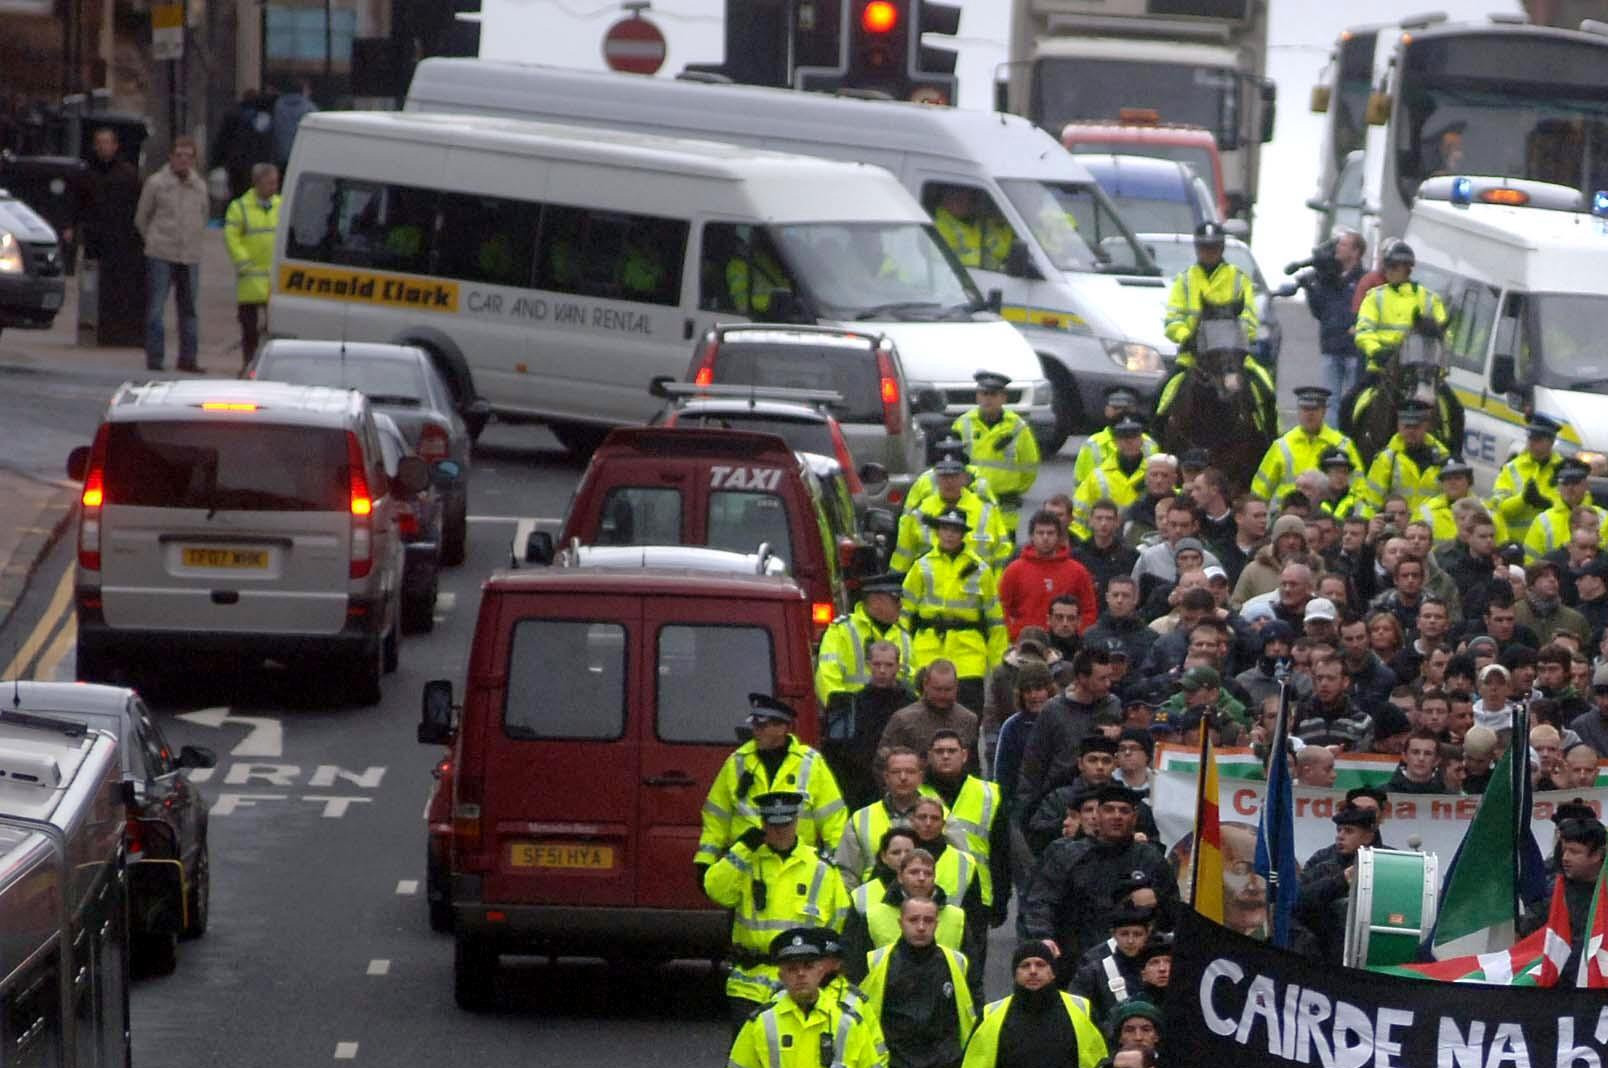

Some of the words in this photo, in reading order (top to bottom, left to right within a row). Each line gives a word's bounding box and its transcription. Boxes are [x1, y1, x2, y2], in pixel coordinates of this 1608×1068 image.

[286, 270, 374, 298] Arnold
[383, 279, 449, 307] Clark
[467, 290, 503, 313] CAR
[511, 297, 547, 320] AND
[554, 302, 585, 324] VAN
[592, 306, 652, 334] RENTAL
[709, 465, 783, 490] TAXI
[208, 793, 374, 819] FT
